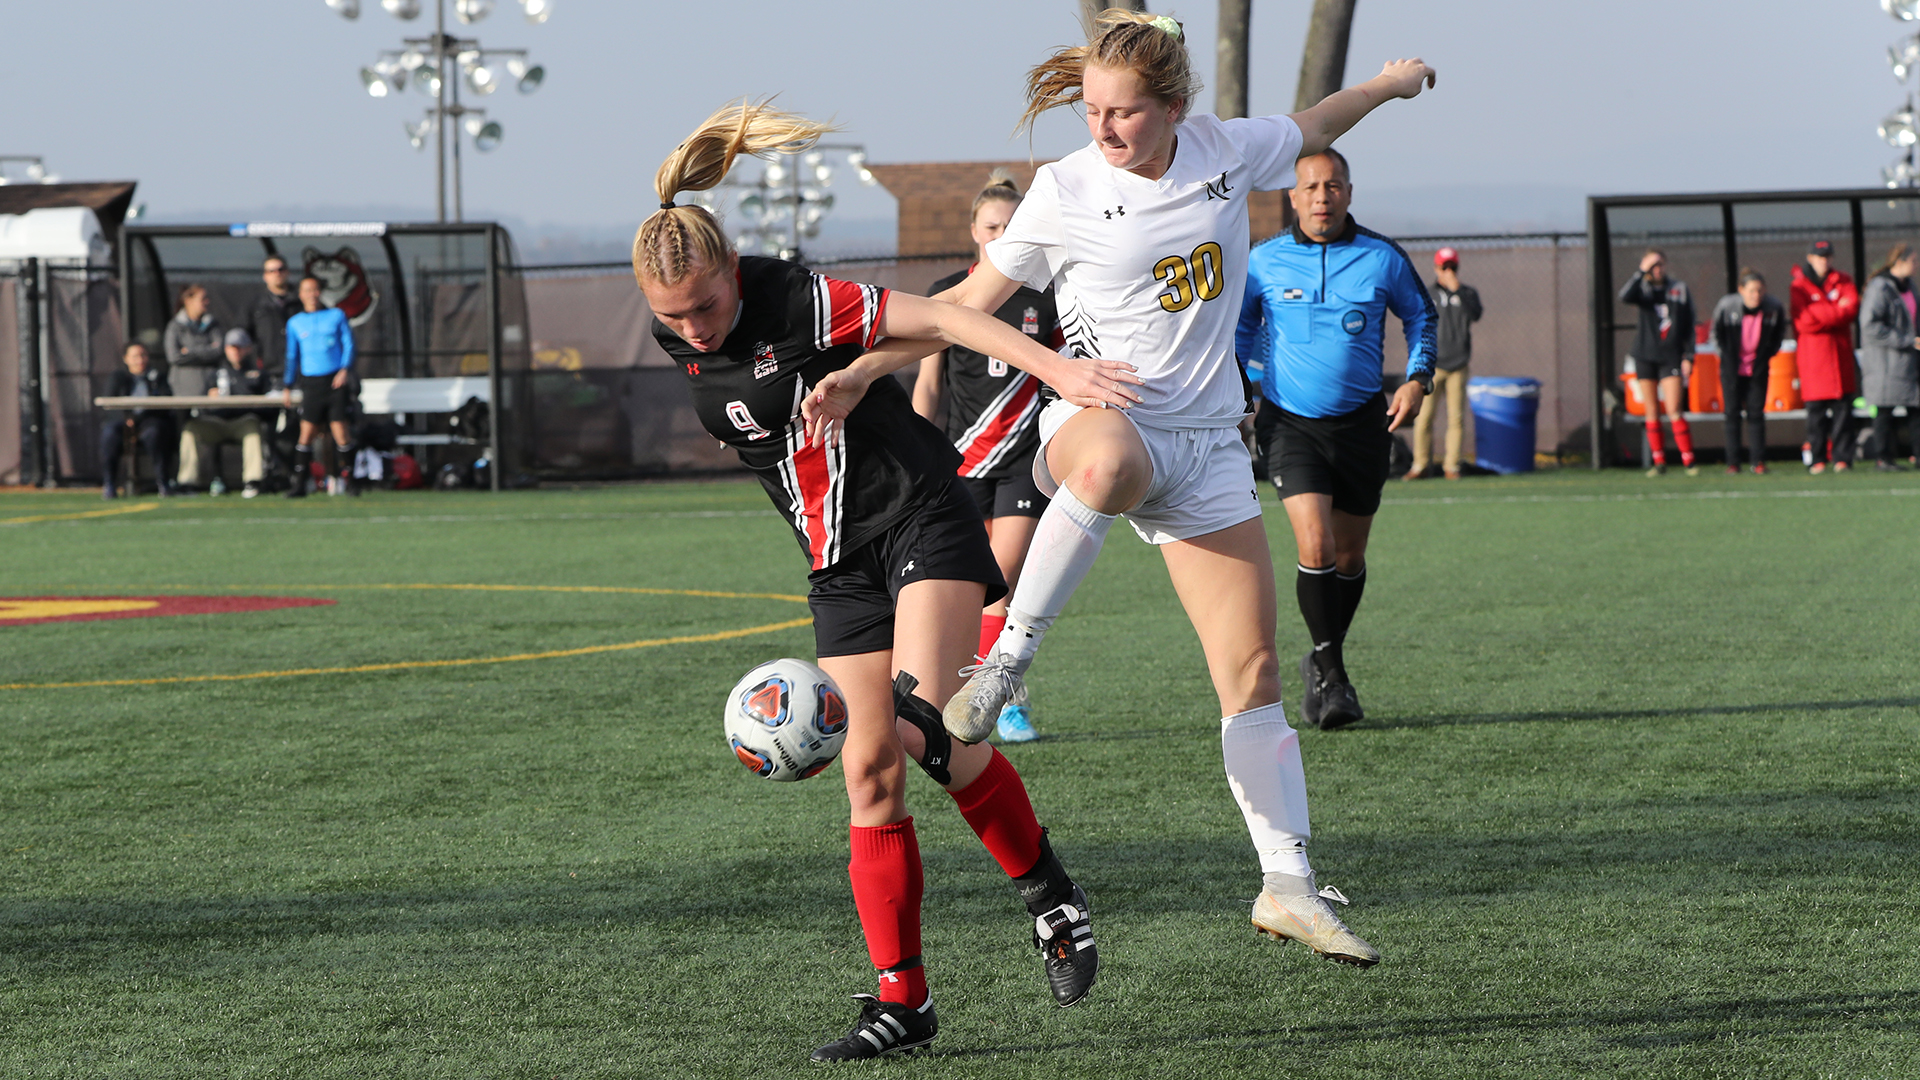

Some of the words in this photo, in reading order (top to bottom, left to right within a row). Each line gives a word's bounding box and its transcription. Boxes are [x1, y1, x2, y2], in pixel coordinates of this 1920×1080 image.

[1153, 241, 1224, 313] 30
[754, 361, 778, 380] ESU
[726, 400, 770, 441] 9
[774, 738, 799, 771] Wilson
[930, 757, 942, 765] KT
[1050, 917, 1068, 928] adidas
